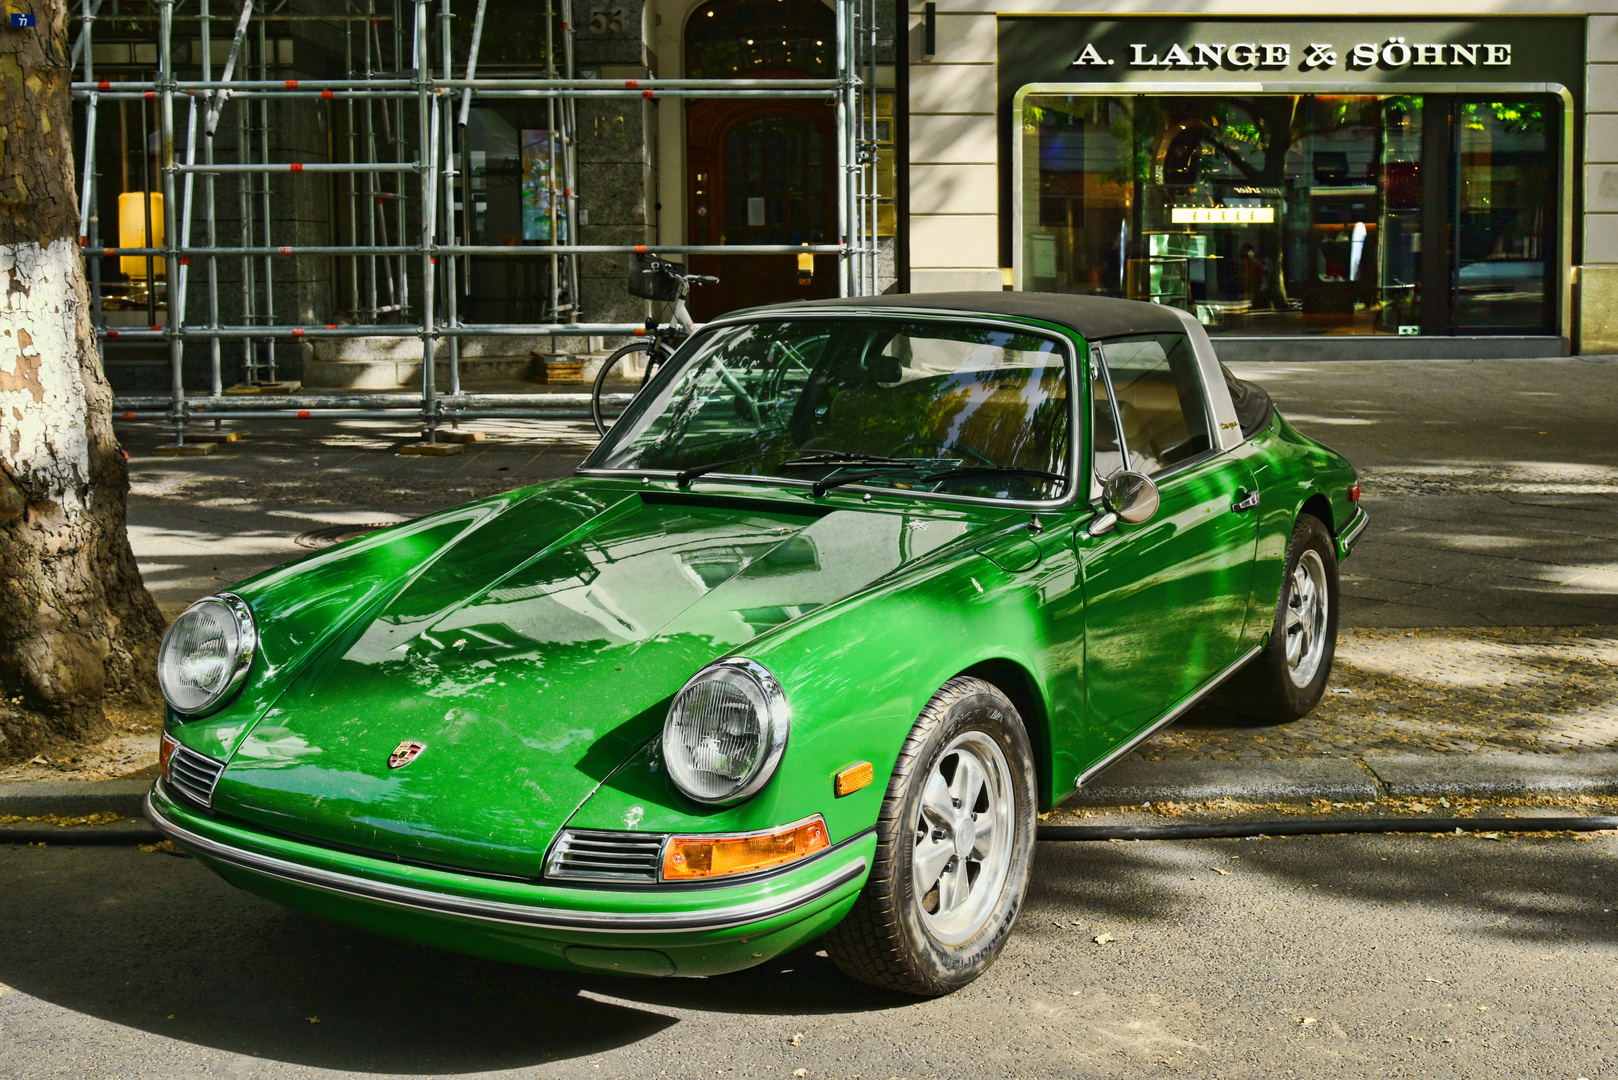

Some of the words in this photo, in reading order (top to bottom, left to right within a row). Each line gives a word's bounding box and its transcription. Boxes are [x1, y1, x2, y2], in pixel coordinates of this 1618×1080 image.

[589, 7, 630, 35] 53
[1072, 43, 1115, 66] A.
[1129, 43, 1291, 66] LANGE
[1305, 43, 1338, 67] &
[1352, 36, 1512, 66] SÖHNE
